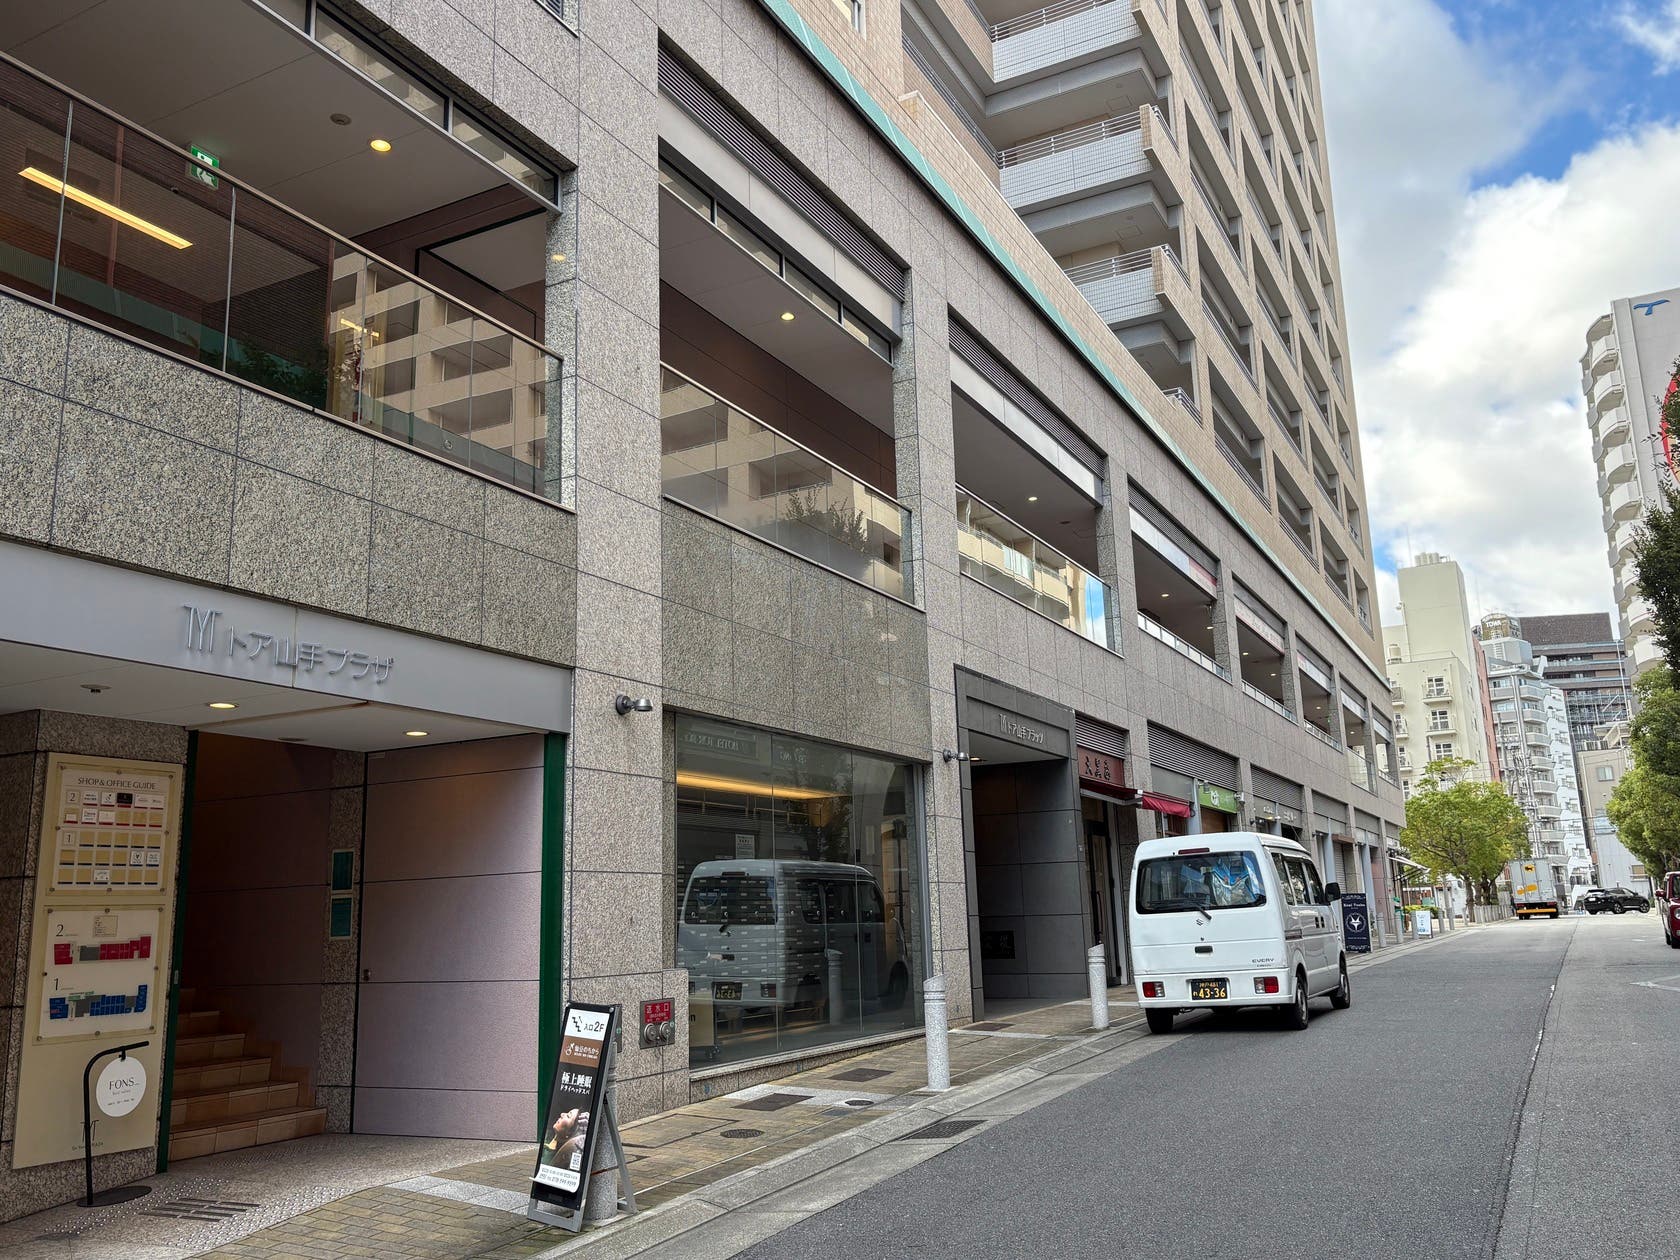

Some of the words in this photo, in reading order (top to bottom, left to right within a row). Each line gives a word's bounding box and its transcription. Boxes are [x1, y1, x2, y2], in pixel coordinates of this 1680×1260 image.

[228, 625, 395, 685] トア山手プラザ
[133, 782, 156, 790] GUIDE
[70, 793, 75, 801] 2
[67, 834, 71, 843] 1
[55, 924, 65, 937] 2
[53, 977, 59, 991] 1
[1198, 987, 1226, 998] 43-36
[561, 1071, 593, 1089] 極上睡眠
